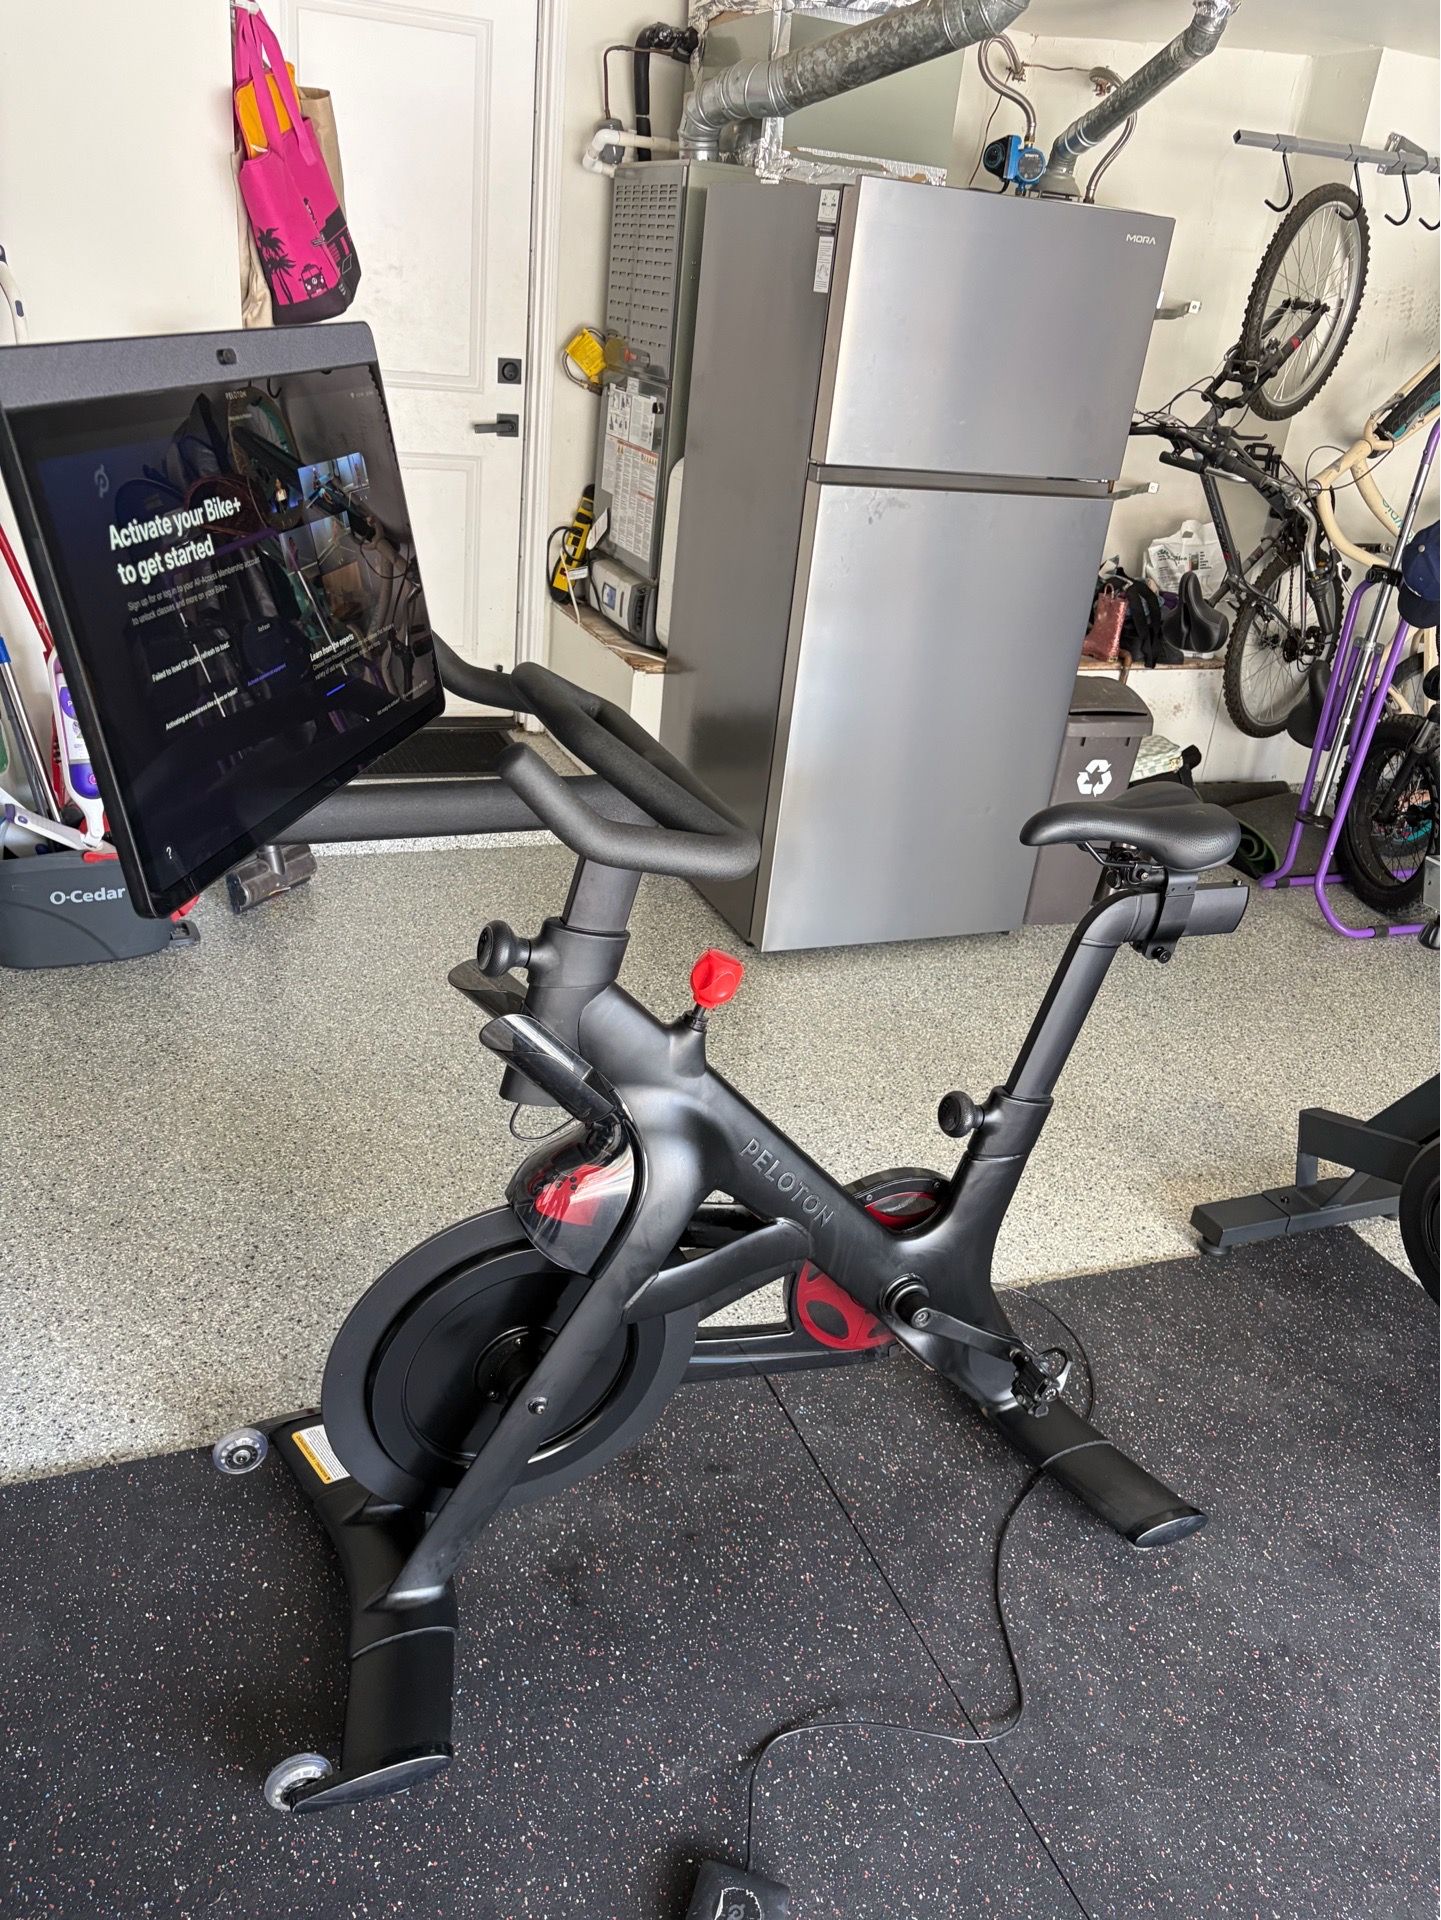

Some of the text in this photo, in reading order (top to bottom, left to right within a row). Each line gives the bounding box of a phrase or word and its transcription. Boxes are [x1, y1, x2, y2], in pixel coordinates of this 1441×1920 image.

[1126, 233, 1156, 245] MORA
[109, 496, 241, 551] Activate your Bike+
[117, 533, 215, 585] to get started
[50, 886, 126, 905] O-Cedar
[739, 1138, 834, 1228] PELOTON
